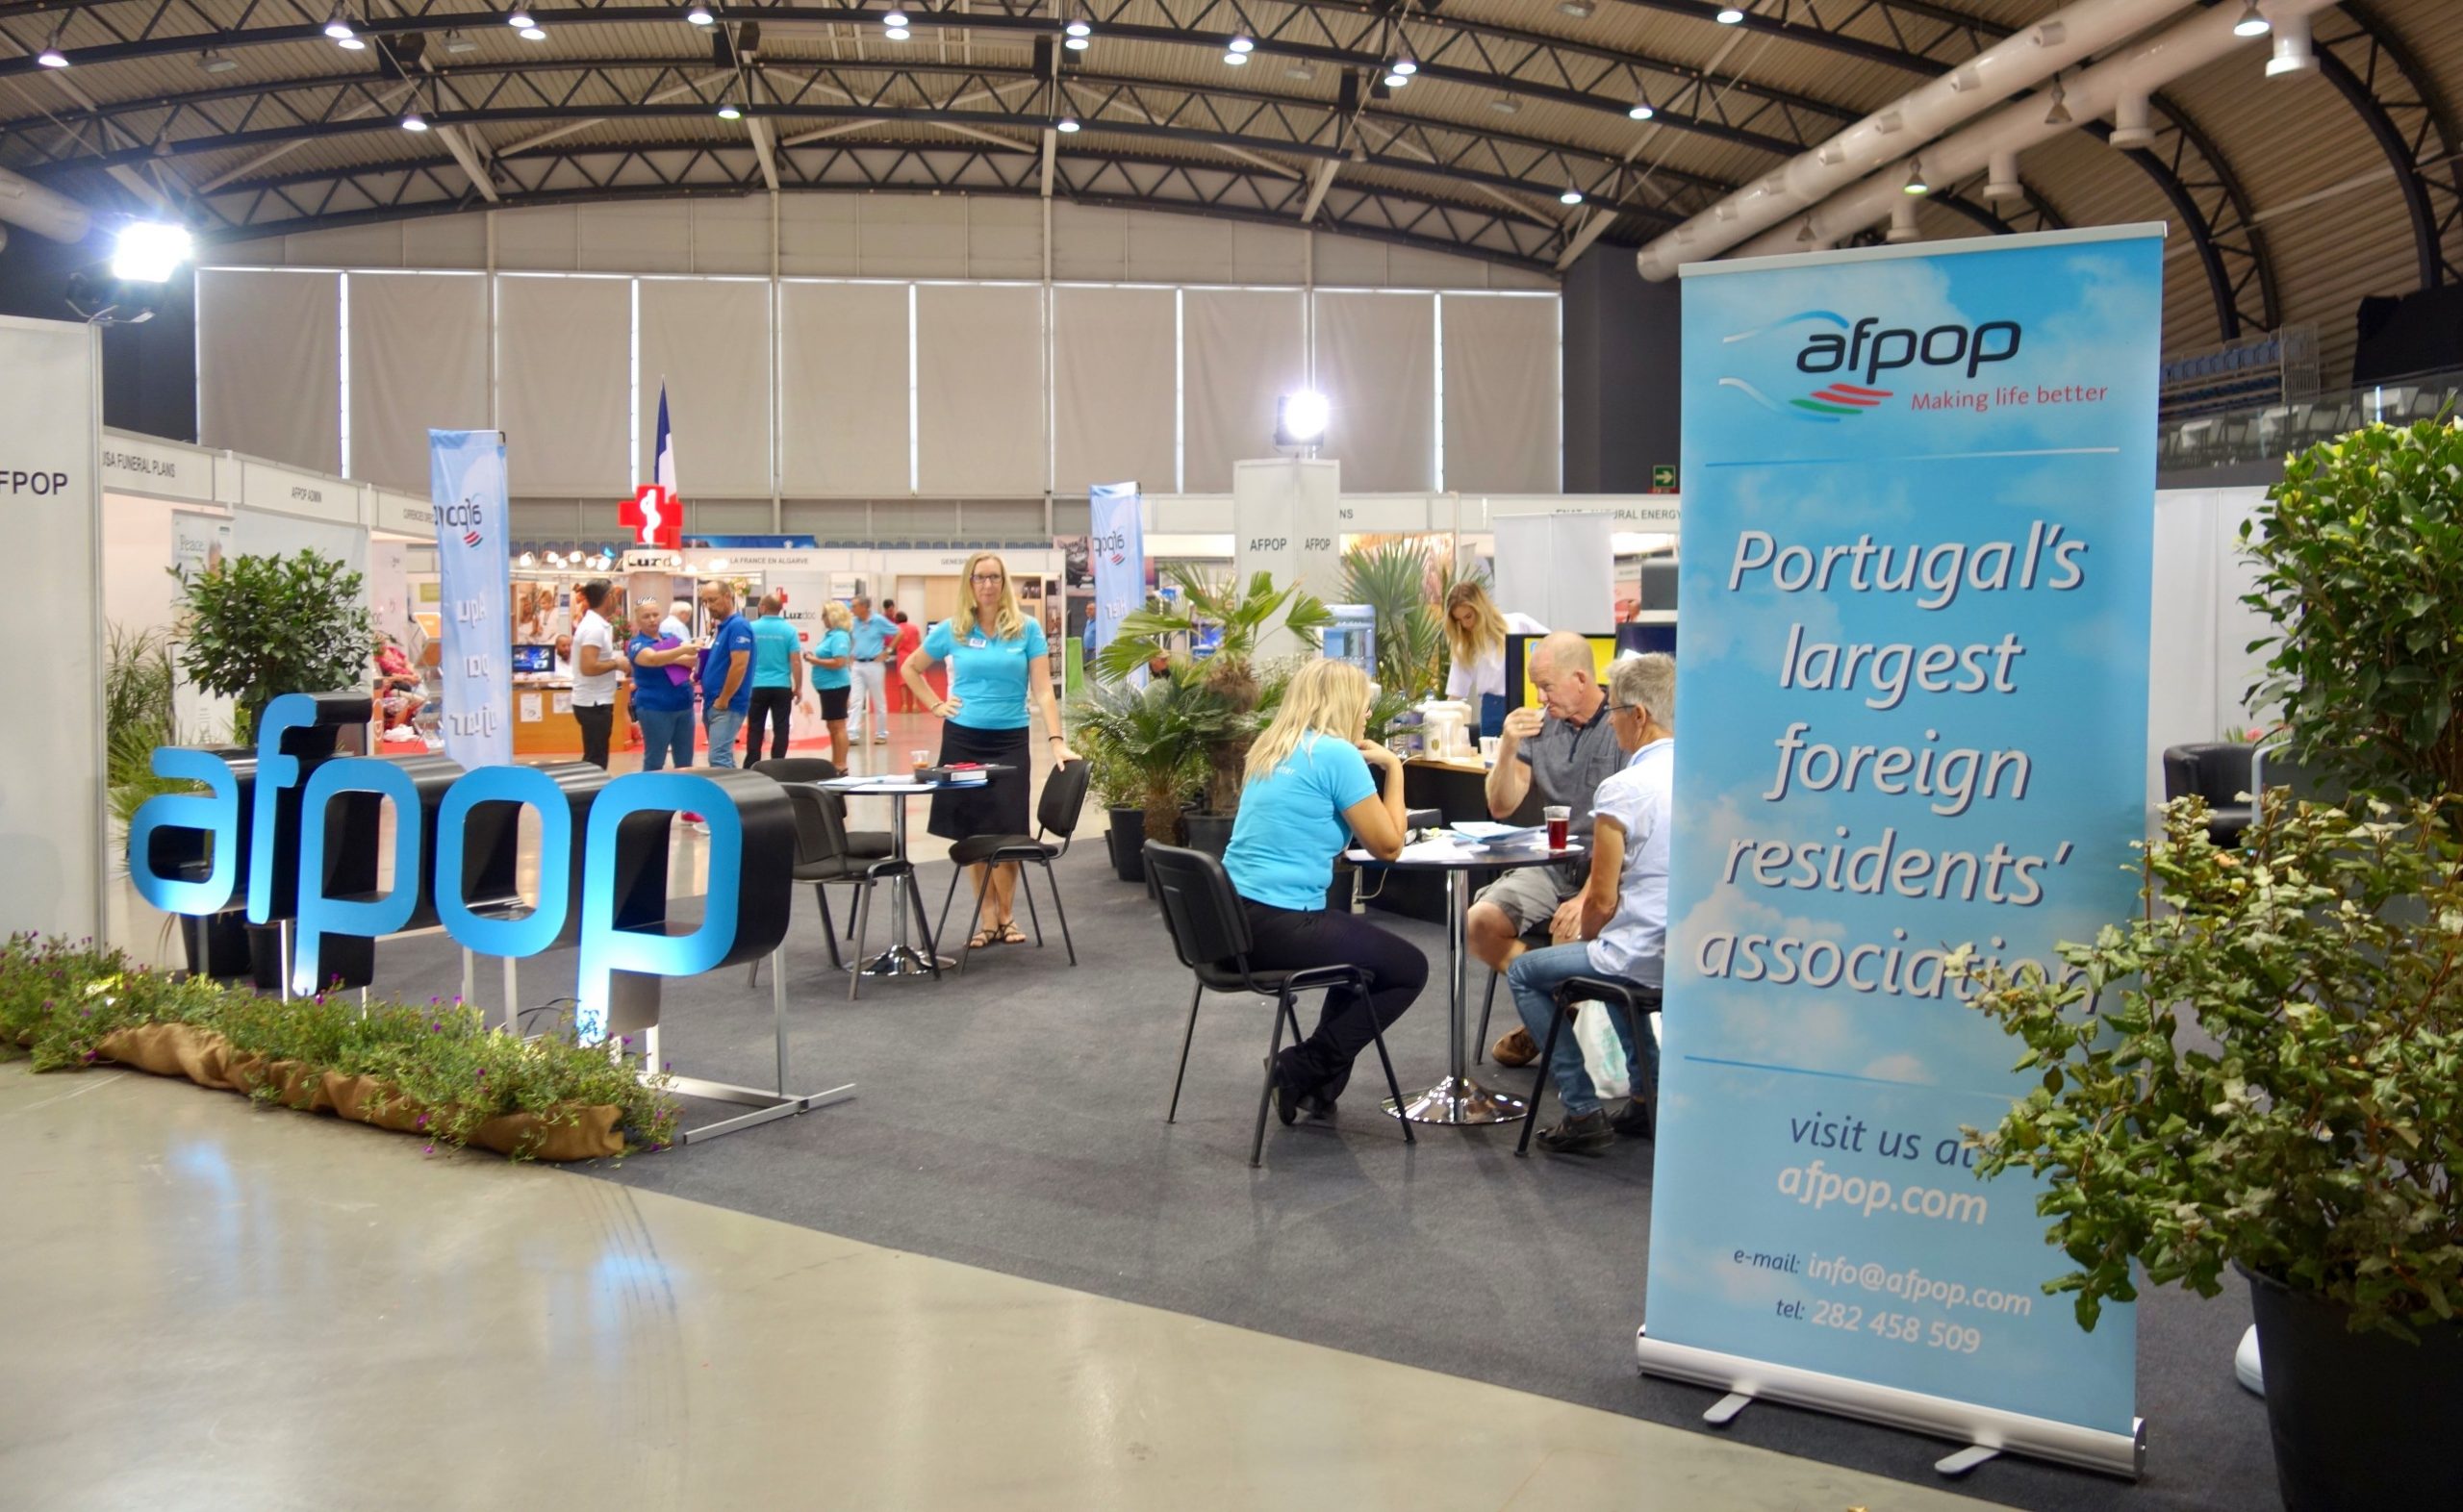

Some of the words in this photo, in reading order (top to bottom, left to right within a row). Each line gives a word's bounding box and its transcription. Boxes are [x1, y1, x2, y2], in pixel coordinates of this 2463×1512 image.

[1795, 316, 2021, 385] afpop
[1911, 391, 1989, 412] Making
[1995, 386, 2029, 406] life
[2037, 384, 2108, 404] better
[740, 557, 766, 566] FRANCE
[767, 557, 777, 566] EN
[778, 557, 808, 566] ALGARVE
[1250, 538, 1287, 552] AFPOP
[1304, 538, 1331, 552] AFPOP
[1728, 519, 2090, 610] Portugal's
[1779, 622, 2026, 711] largest
[1763, 722, 2032, 818] foreign
[130, 693, 743, 1047] afpop
[1723, 826, 2075, 907] residents'
[1791, 1112, 1867, 1152] visit
[1878, 1129, 1921, 1161] us
[1777, 1160, 1988, 1224] afpop.com
[1734, 1247, 1800, 1274] e-mail:
[1808, 1252, 2031, 1316] info@afpop.com
[1776, 1298, 1805, 1320] tel:
[1811, 1299, 1863, 1332] 282
[1868, 1312, 1920, 1343] 458
[1928, 1322, 1982, 1353] 509
